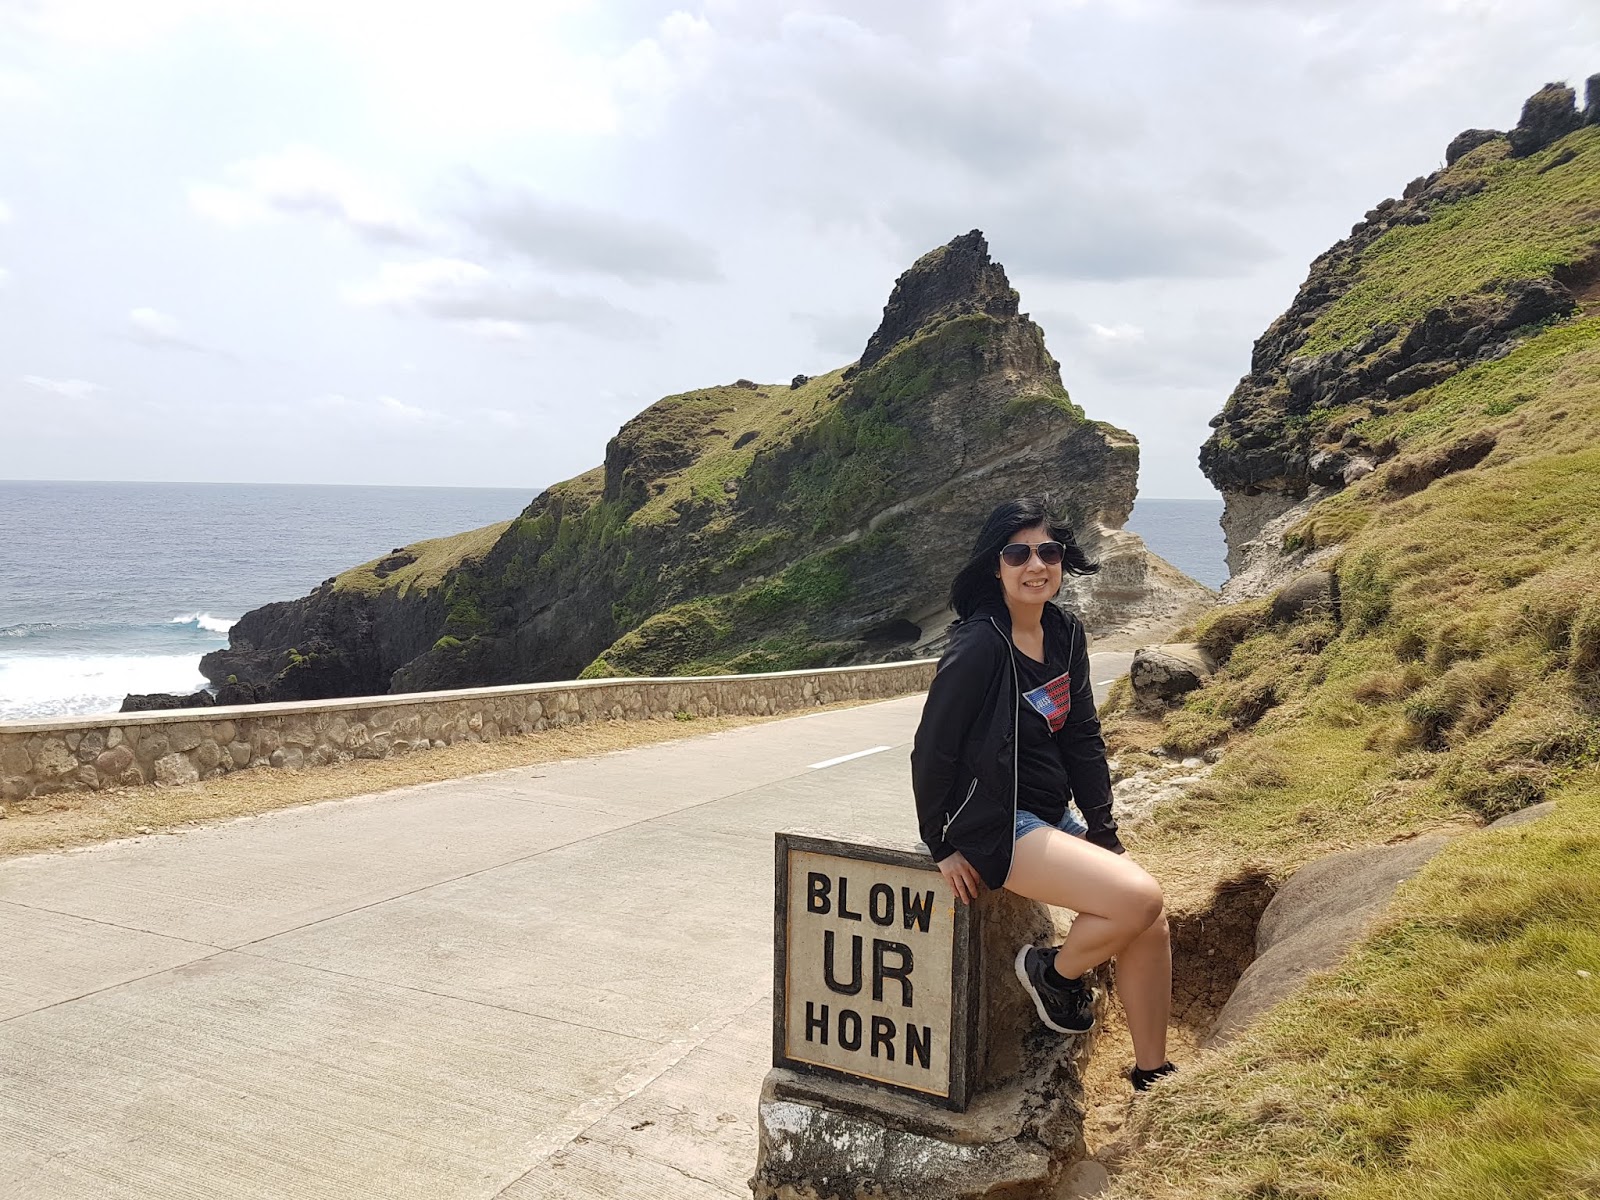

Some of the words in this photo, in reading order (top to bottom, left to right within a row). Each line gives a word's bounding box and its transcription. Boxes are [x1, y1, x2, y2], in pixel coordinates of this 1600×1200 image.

[806, 871, 935, 933] BLOW
[823, 930, 914, 1008] UR
[805, 1001, 932, 1070] HORN
